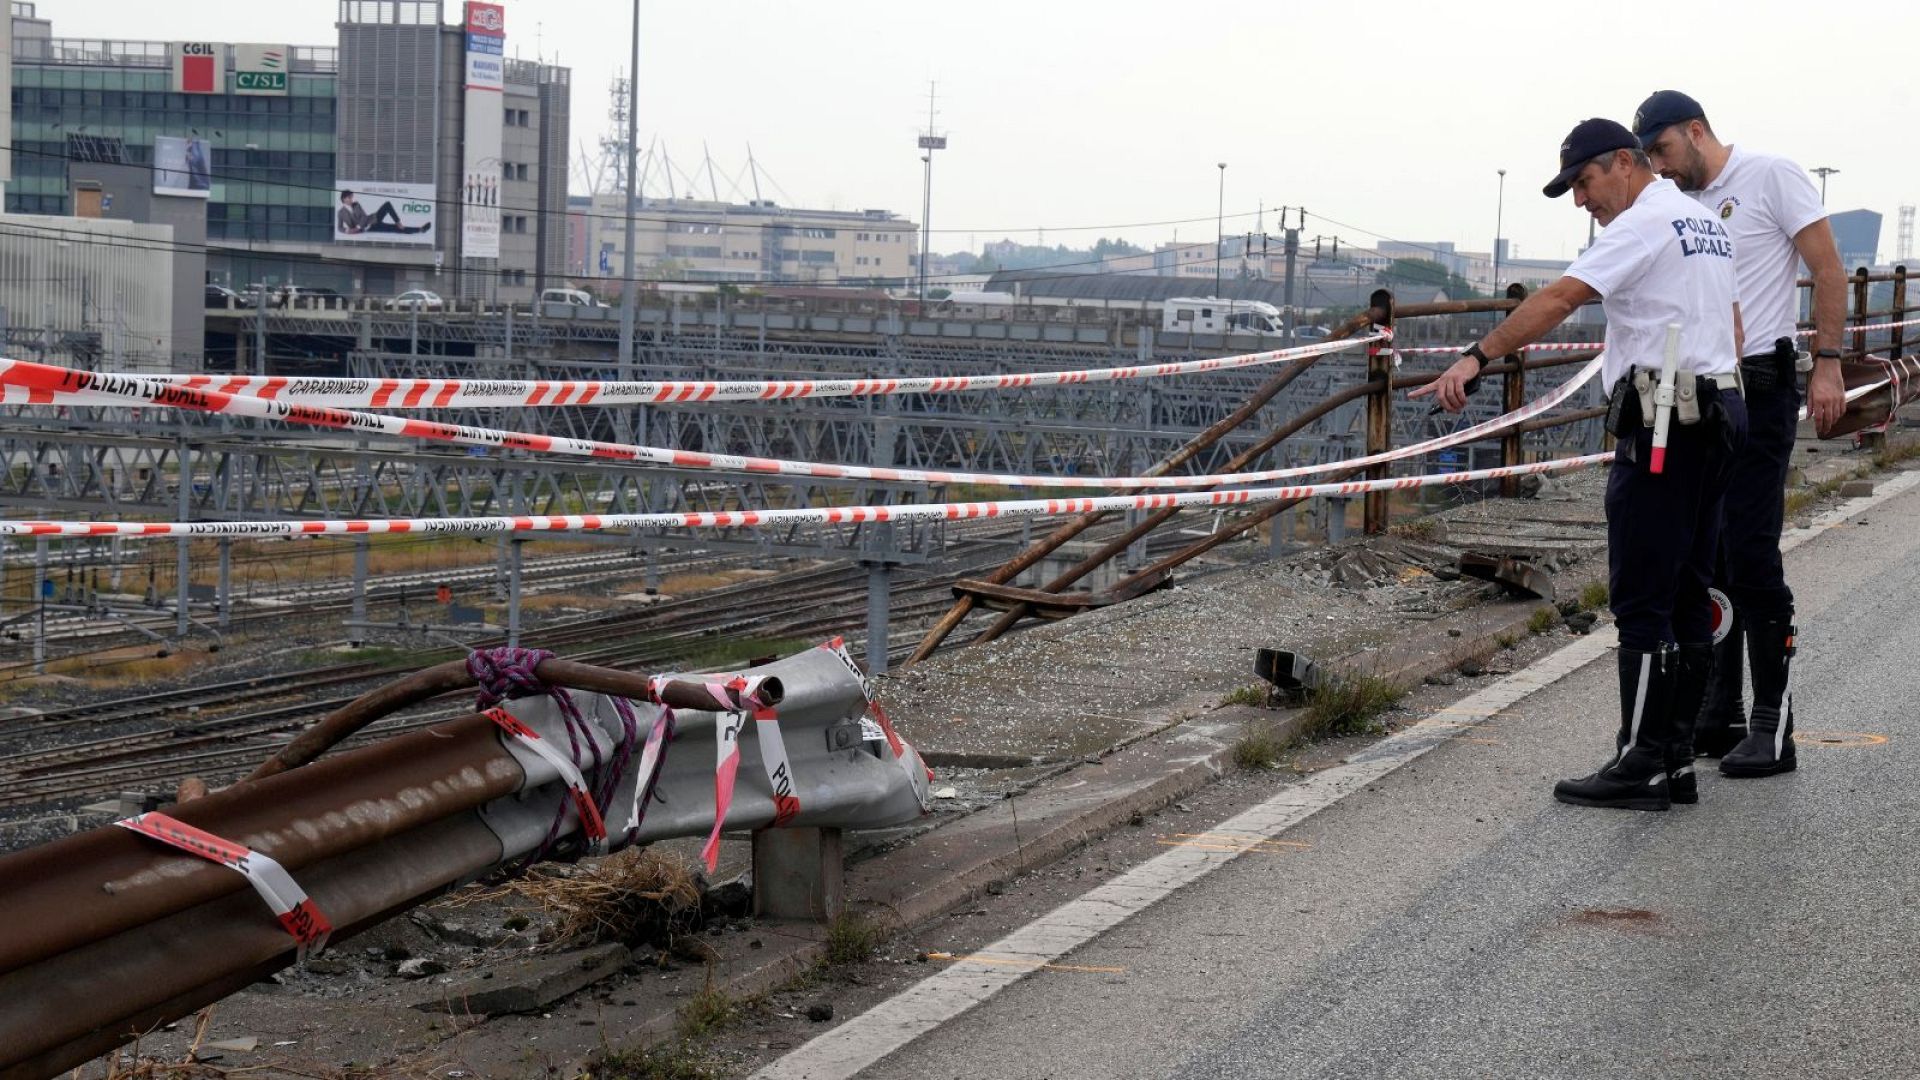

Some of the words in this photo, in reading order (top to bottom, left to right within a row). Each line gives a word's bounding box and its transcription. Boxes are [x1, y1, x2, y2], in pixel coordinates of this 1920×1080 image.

[183, 43, 214, 55] CGIL
[238, 74, 283, 88] CISL
[402, 202, 431, 214] nico
[1672, 217, 1728, 239] POLIZIA
[1680, 236, 1732, 259] LOCALE
[289, 379, 369, 396] CARABINIERI
